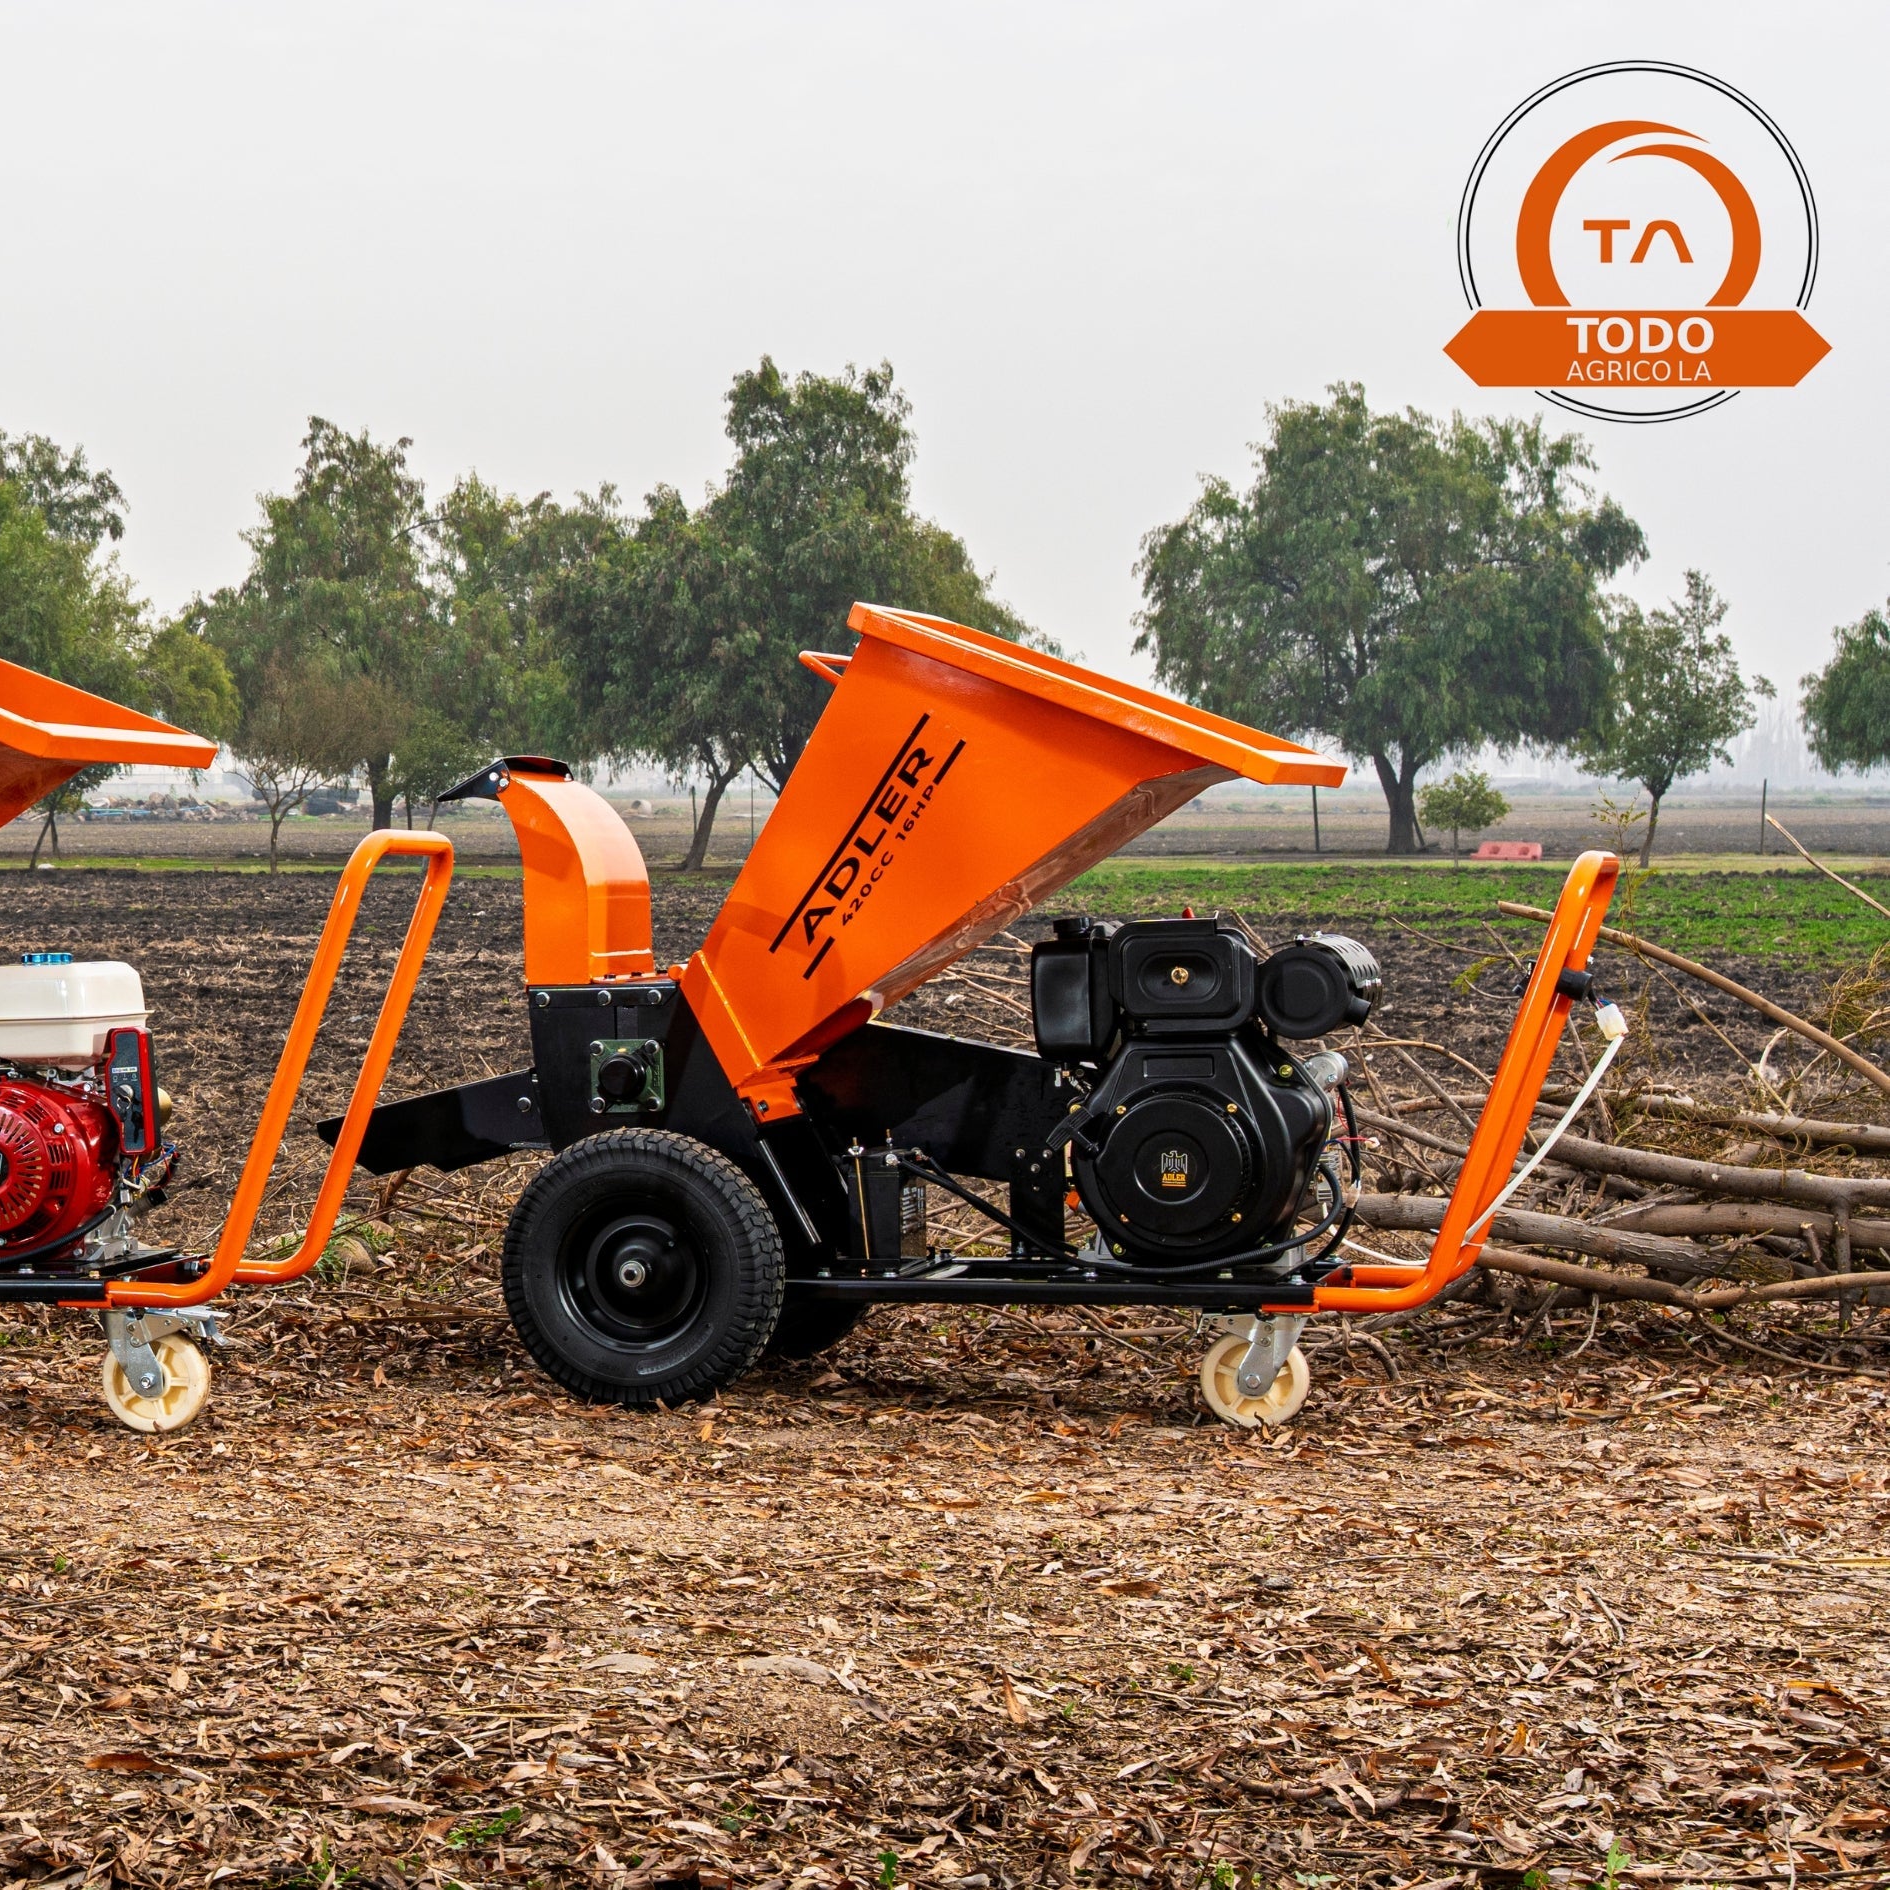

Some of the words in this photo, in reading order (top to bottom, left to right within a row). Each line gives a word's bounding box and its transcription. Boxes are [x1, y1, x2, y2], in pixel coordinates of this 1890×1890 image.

[802, 747, 934, 946] ADLER
[842, 851, 894, 926] 420CC
[895, 784, 935, 841] 16HP
[1162, 1173, 1186, 1182] ADLER
